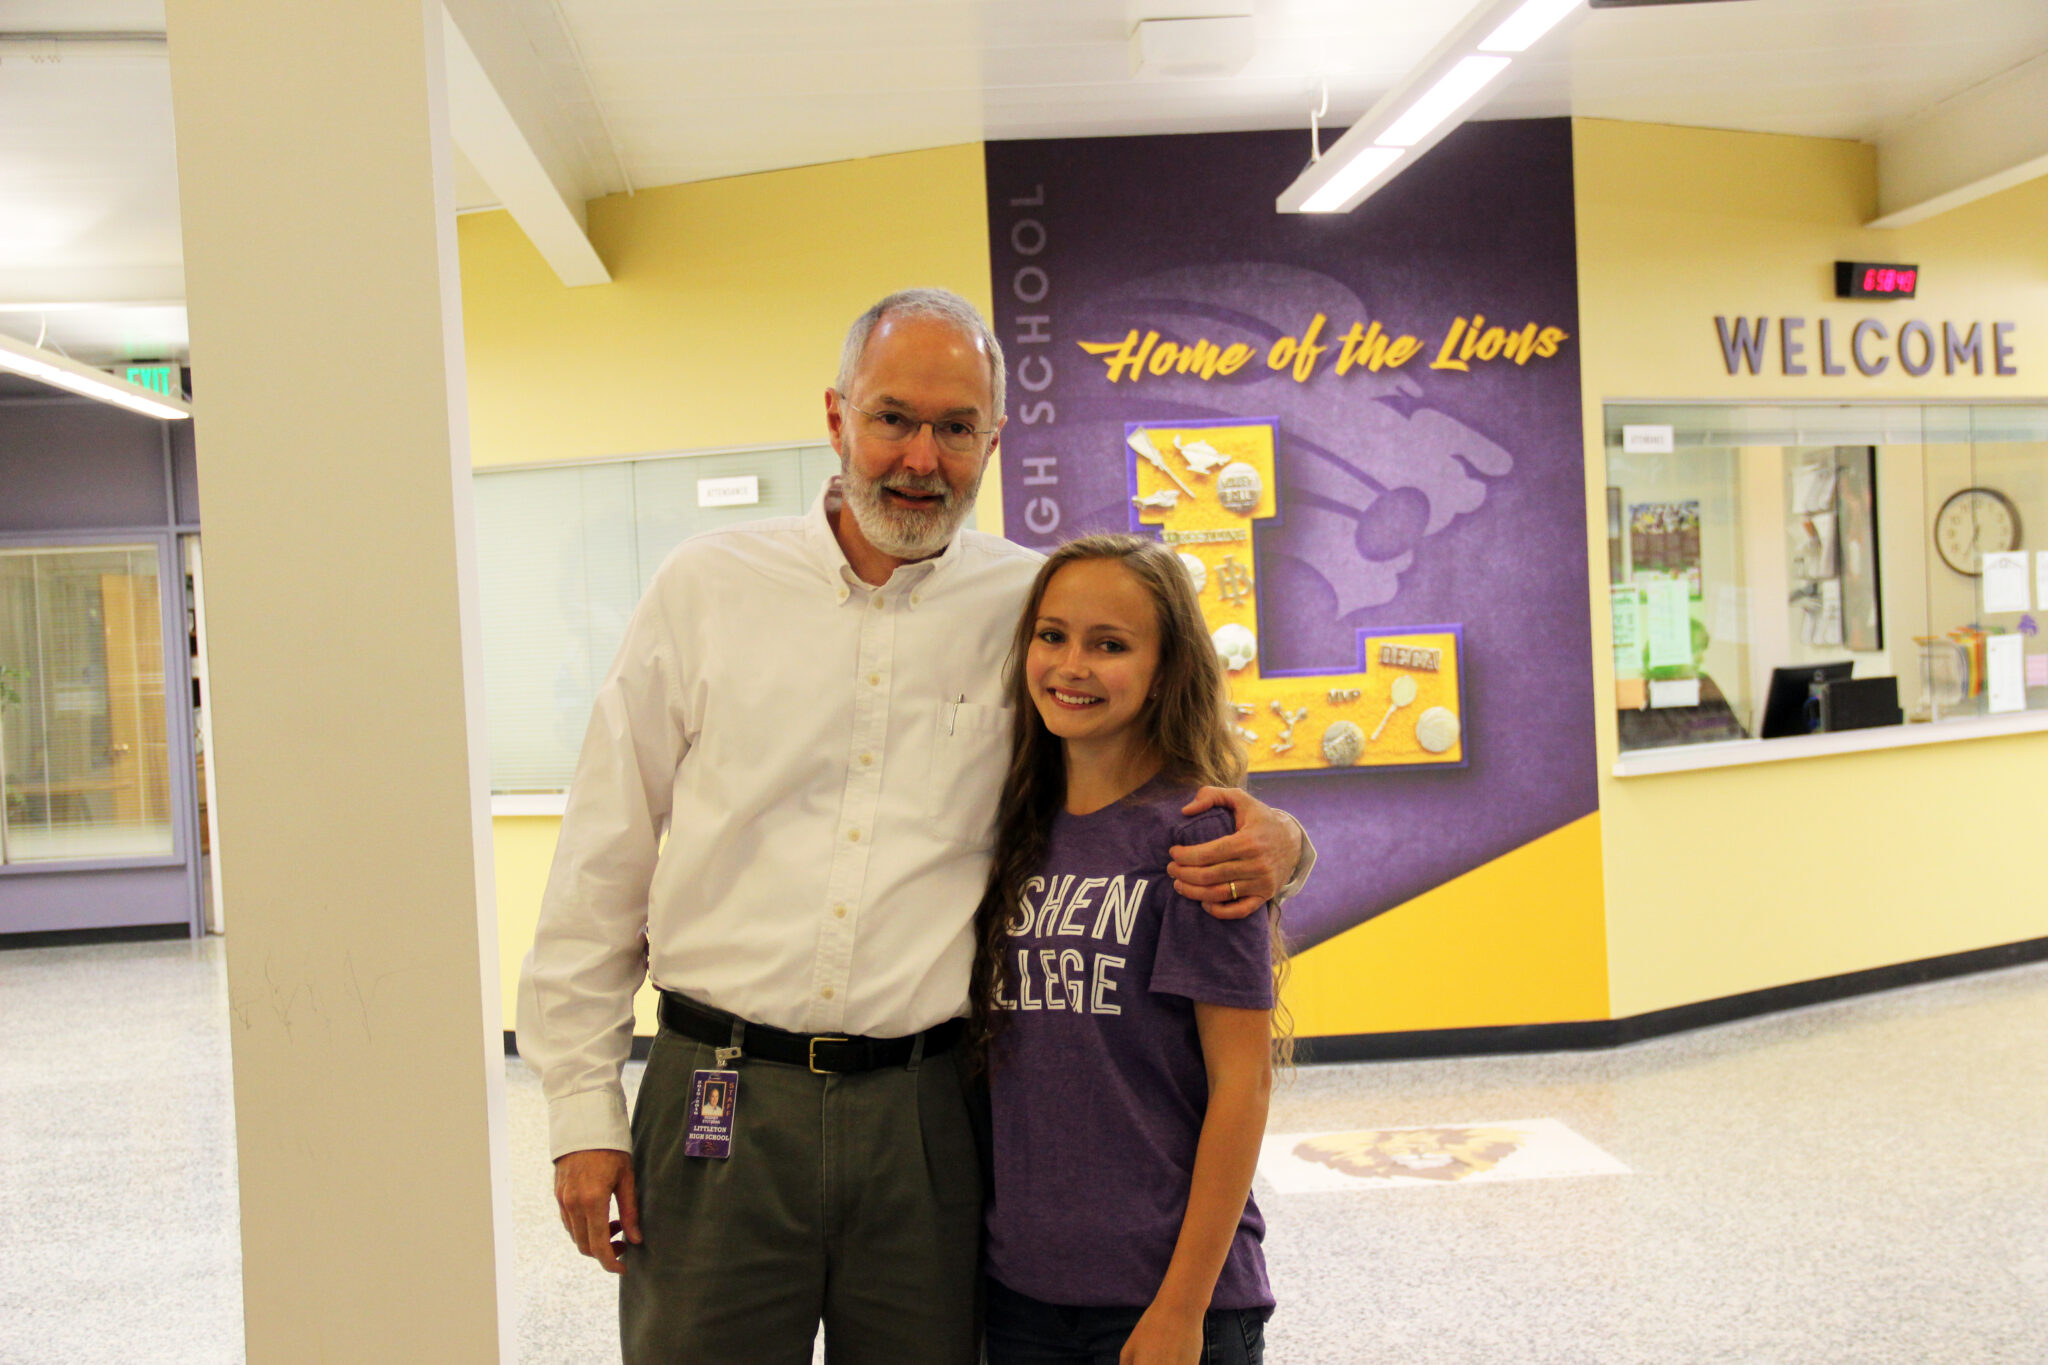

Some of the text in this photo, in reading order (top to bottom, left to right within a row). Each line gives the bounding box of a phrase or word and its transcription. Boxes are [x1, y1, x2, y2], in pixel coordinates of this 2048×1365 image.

[1010, 183, 1061, 535] GH SCHOOL
[1076, 312, 1570, 383] Home of the Lions
[1714, 316, 2017, 377] WELCOME
[1005, 874, 1149, 946] SHEN
[693, 1125, 727, 1133] LITTLETON
[705, 1134, 730, 1142] SCHOOL
